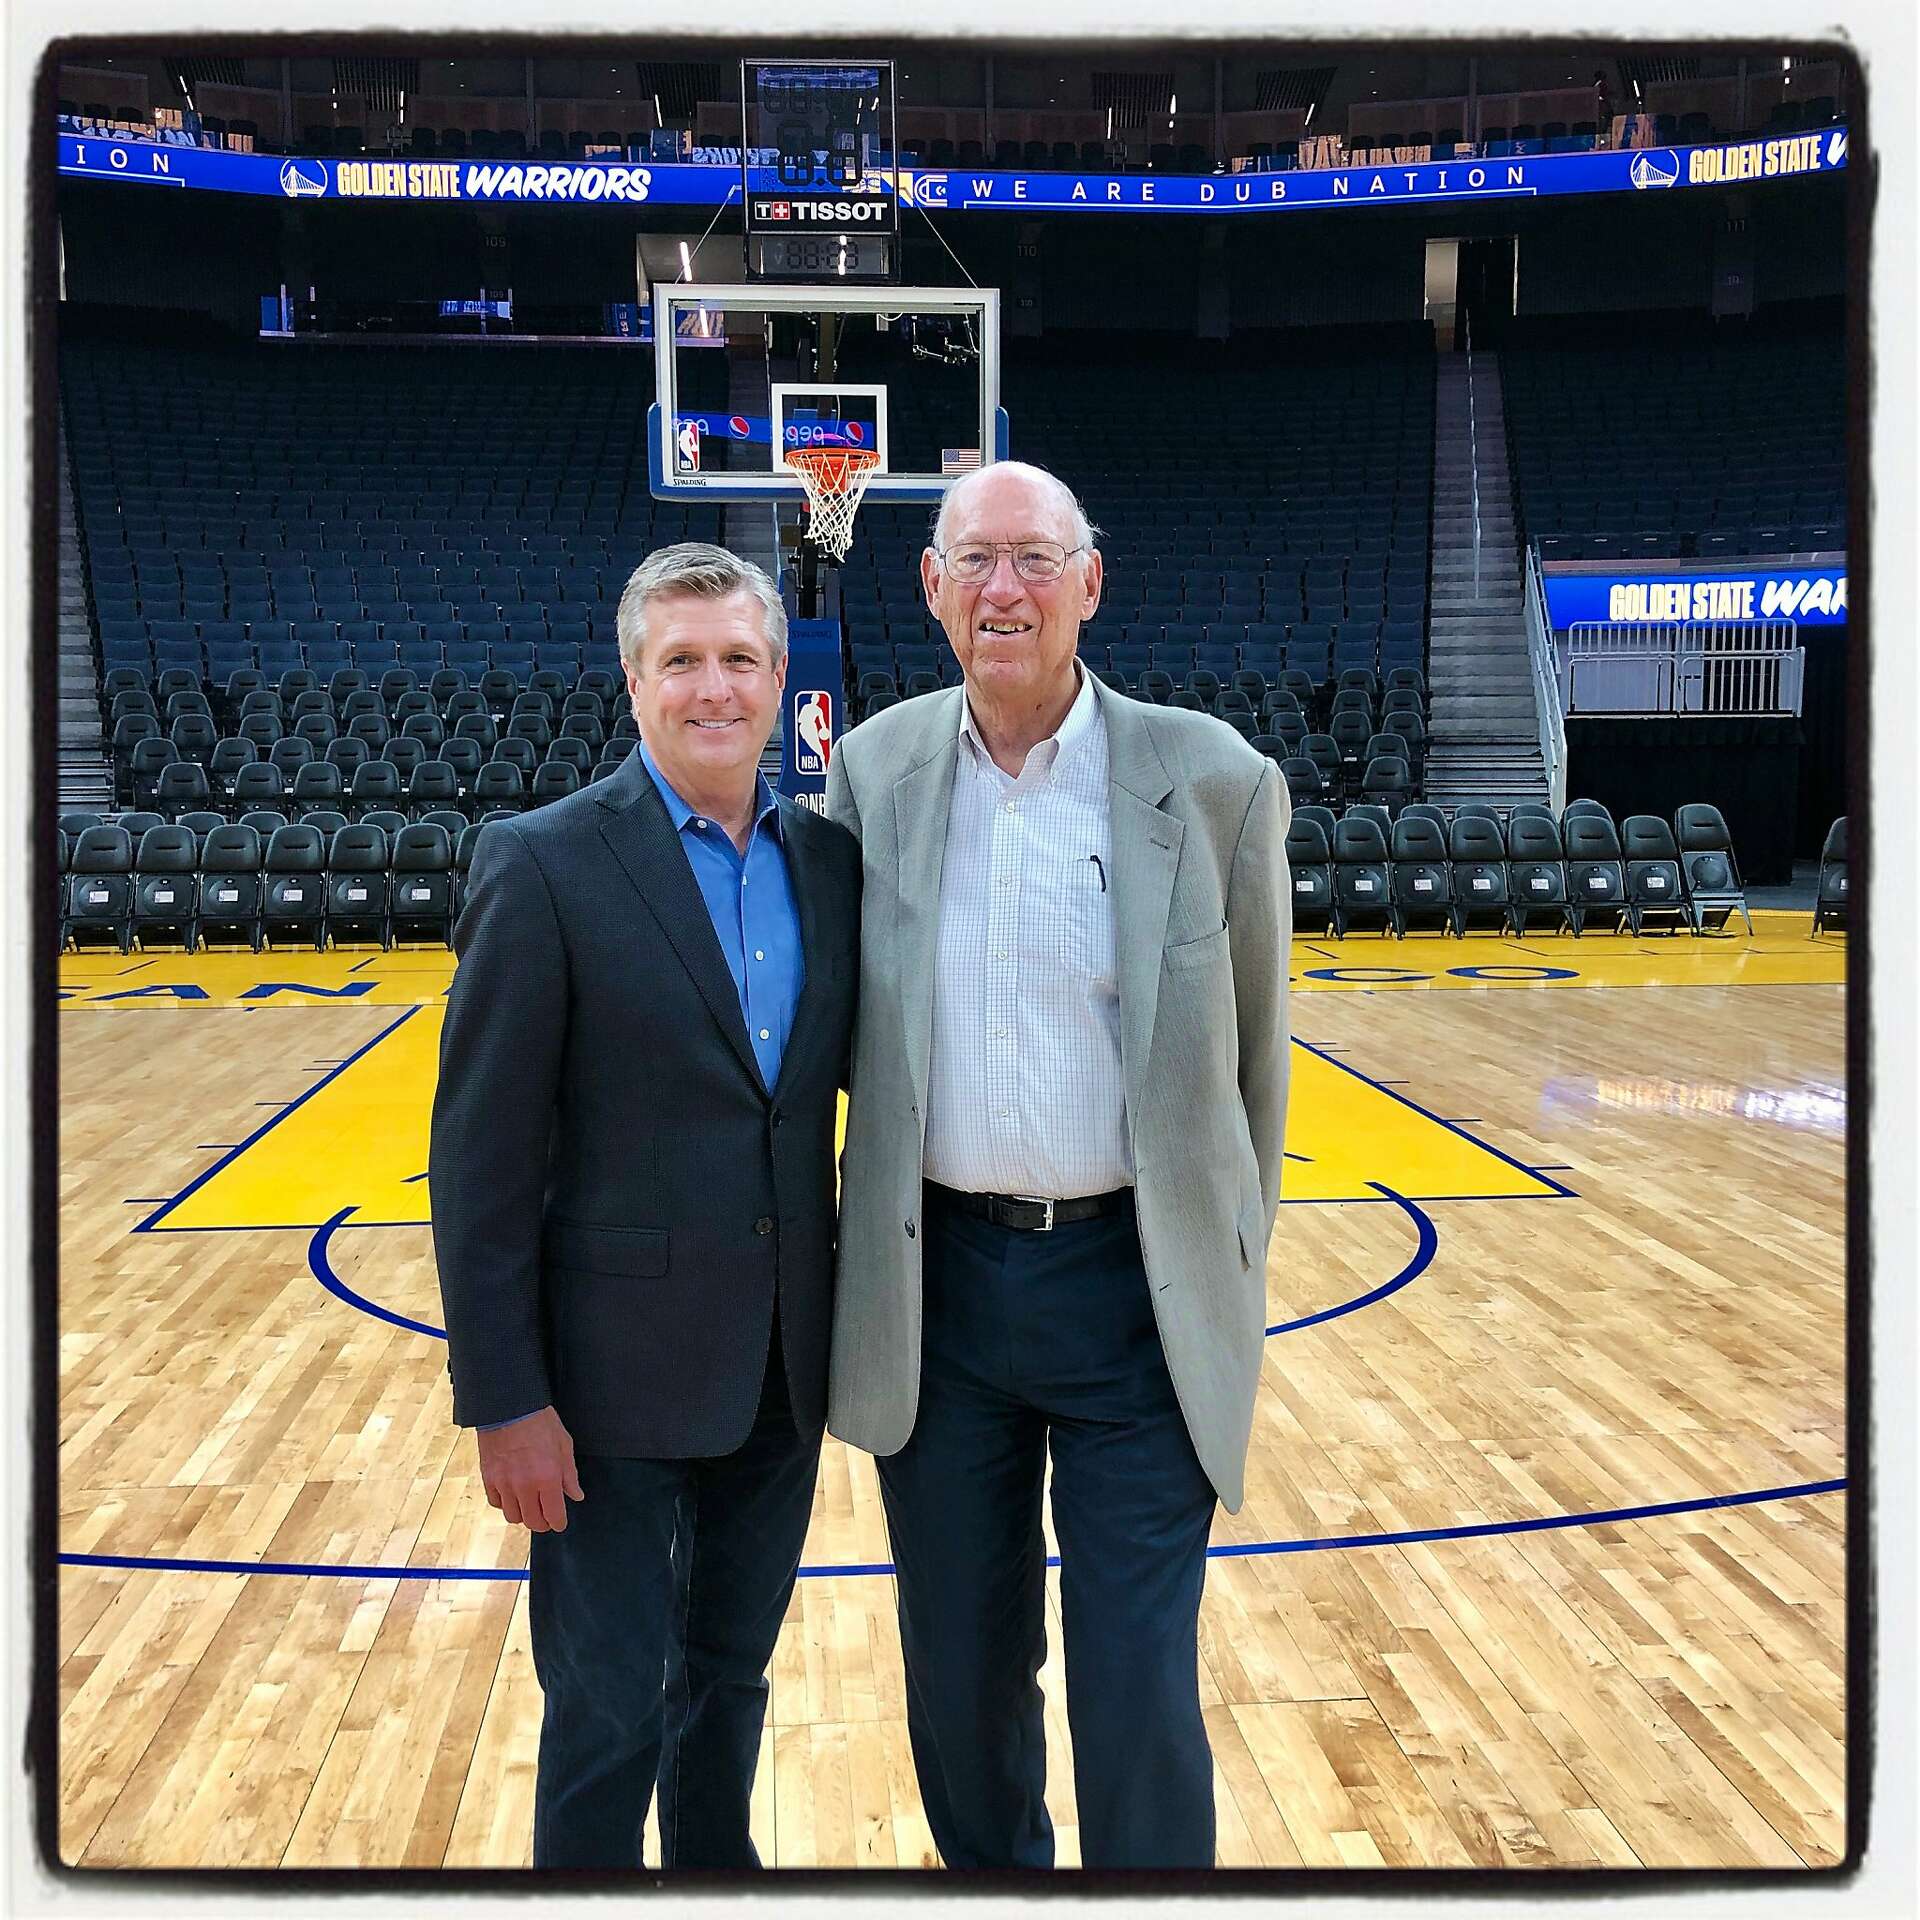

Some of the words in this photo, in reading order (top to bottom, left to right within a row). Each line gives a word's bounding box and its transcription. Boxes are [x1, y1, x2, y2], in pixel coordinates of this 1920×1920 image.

[1689, 143, 1762, 184] GOLDEN
[1764, 135, 1822, 175] STATE
[337, 163, 405, 196] GOLDEN
[409, 163, 460, 198] STATE
[465, 165, 651, 200] WARRIORS
[972, 179, 1026, 199] WE
[1072, 182, 1155, 201] ARE
[1200, 180, 1286, 202] DUB
[1333, 166, 1523, 195] NATION
[791, 202, 887, 221] TISSOT
[1609, 583, 1691, 621] GOLDEN
[1692, 581, 1755, 619] STATE
[801, 756, 819, 769] NBA
[57, 983, 382, 1001] AN
[1290, 966, 1580, 983] CO
